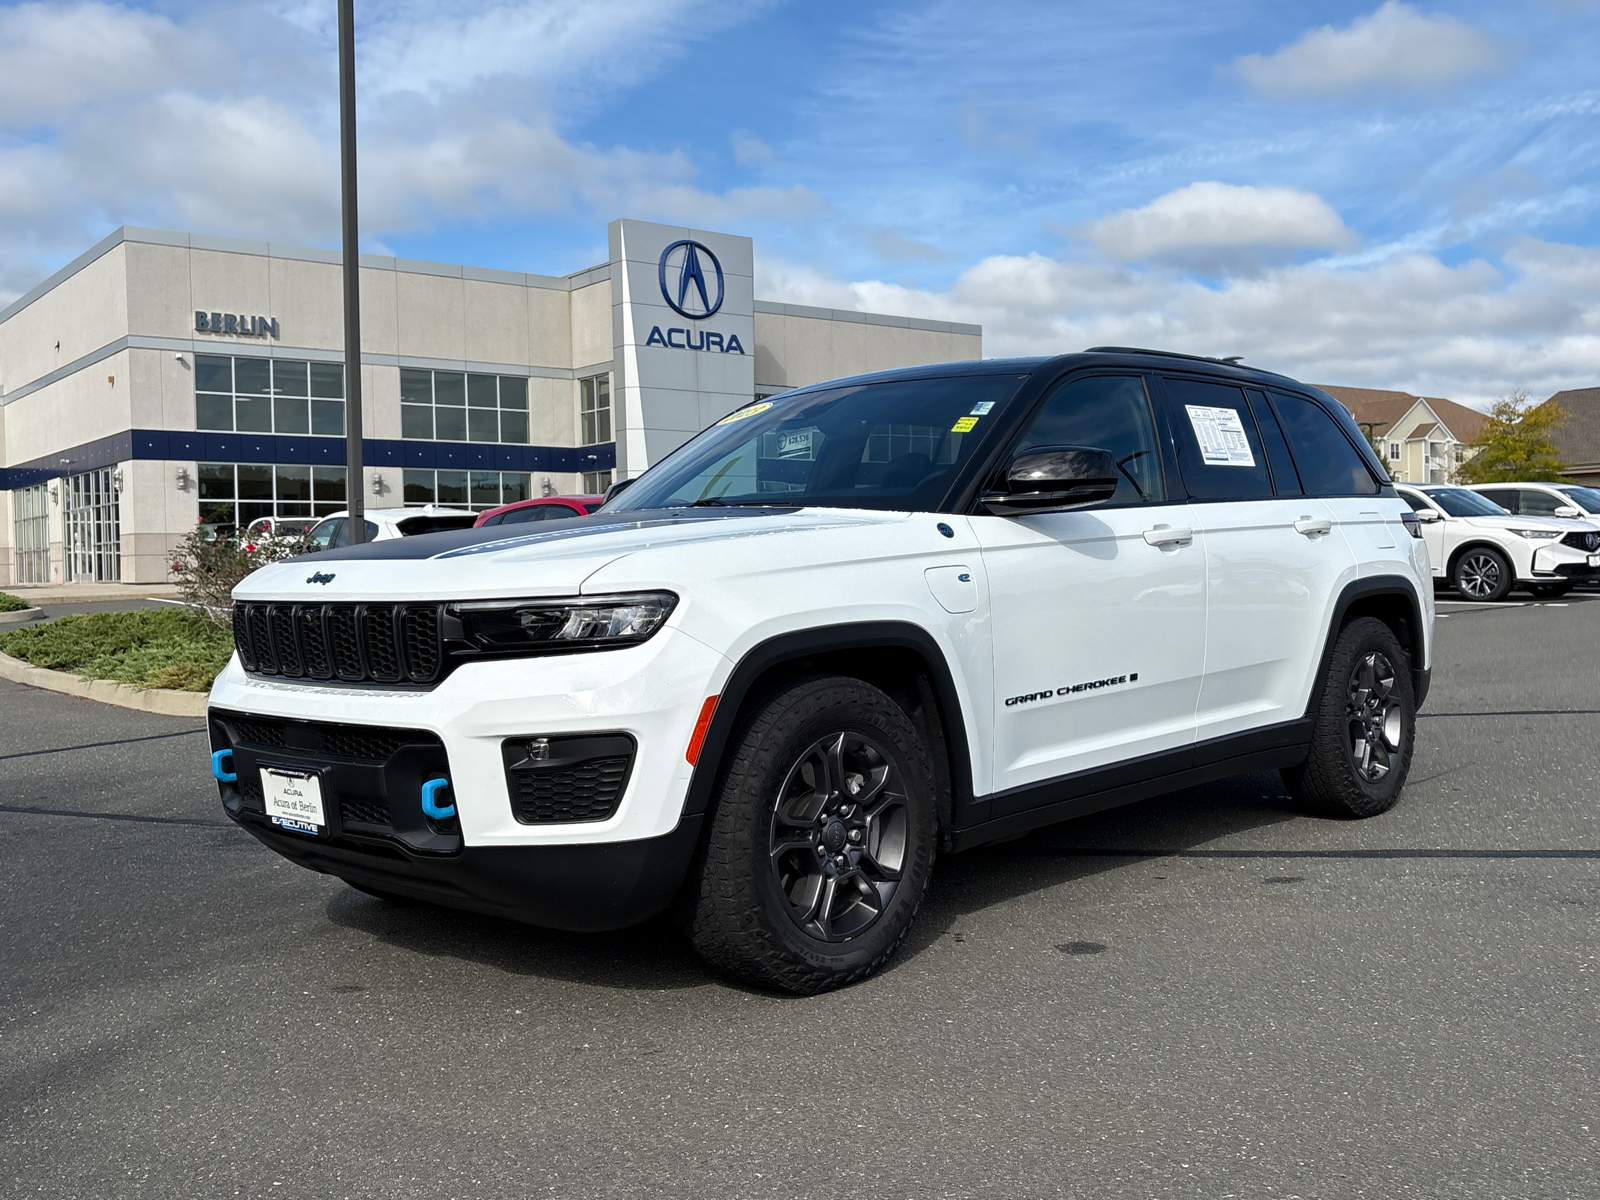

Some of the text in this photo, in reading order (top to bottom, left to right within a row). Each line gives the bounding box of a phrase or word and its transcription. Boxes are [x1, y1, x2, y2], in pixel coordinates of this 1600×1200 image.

[195, 311, 276, 338] BERLIN
[646, 326, 745, 354] ACURA
[306, 571, 336, 585] Jeep
[1005, 675, 1127, 706] GRAND CHEROKEE
[283, 788, 303, 797] ACURA
[273, 796, 318, 814] Acura of Berlin
[271, 816, 318, 832] EXECUTIVE
